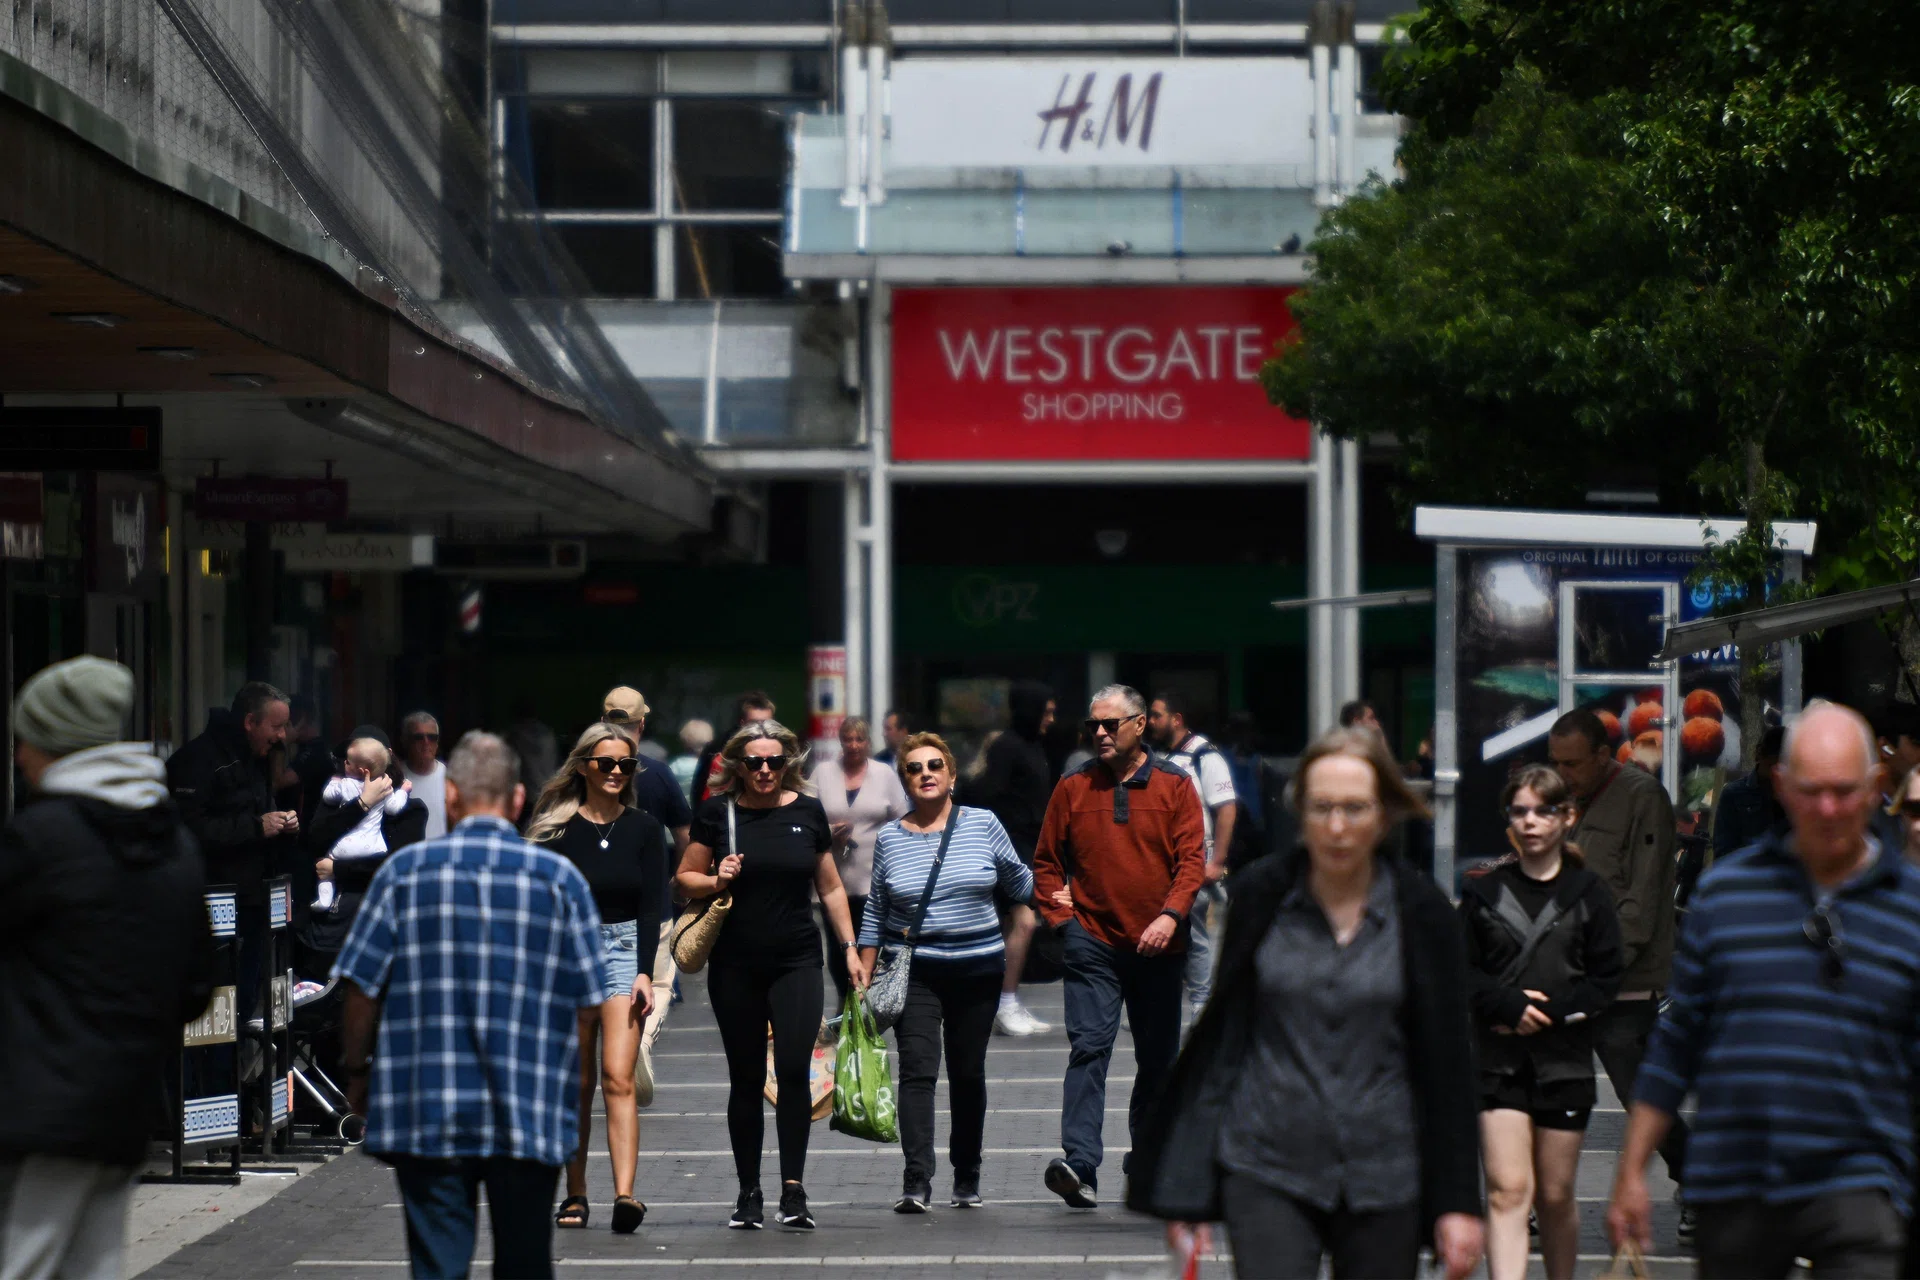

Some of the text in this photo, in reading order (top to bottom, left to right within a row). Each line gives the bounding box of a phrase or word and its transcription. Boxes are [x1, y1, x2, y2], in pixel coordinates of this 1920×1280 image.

[1037, 71, 1163, 152] H&M
[939, 327, 1262, 383] WESTGATE
[1022, 392, 1184, 421] SHOPPING
[1522, 550, 1588, 563] ORIGINAL
[1645, 551, 1662, 563] OF
